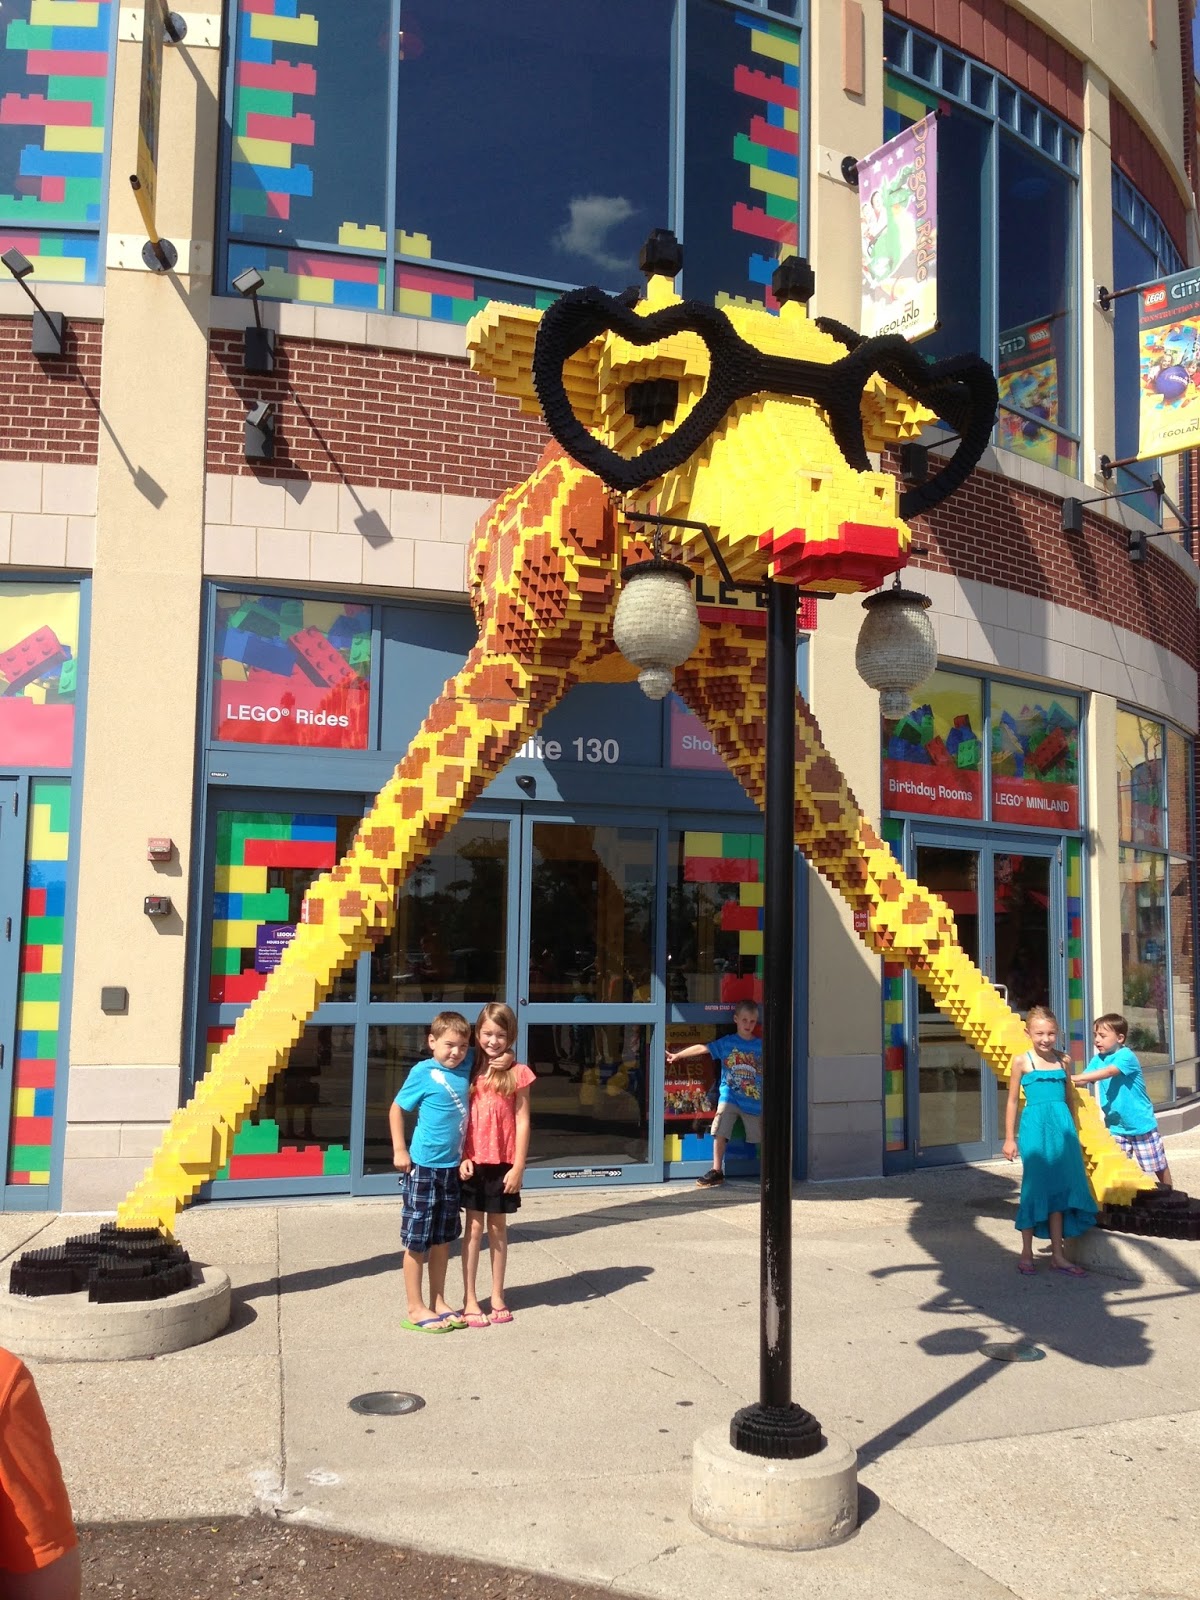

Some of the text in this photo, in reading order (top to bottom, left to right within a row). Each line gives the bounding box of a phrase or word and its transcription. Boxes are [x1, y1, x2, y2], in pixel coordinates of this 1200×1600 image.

[909, 118, 935, 283] Dragon Ride
[1145, 291, 1166, 306] LEGO
[875, 306, 920, 337] LEGOLAND
[1159, 420, 1200, 438] LEGOLAN
[296, 709, 349, 728] Rides
[515, 736, 620, 763] uite 130
[889, 779, 973, 801] Birthday Rooms
[1026, 797, 1070, 813] MINILAND
